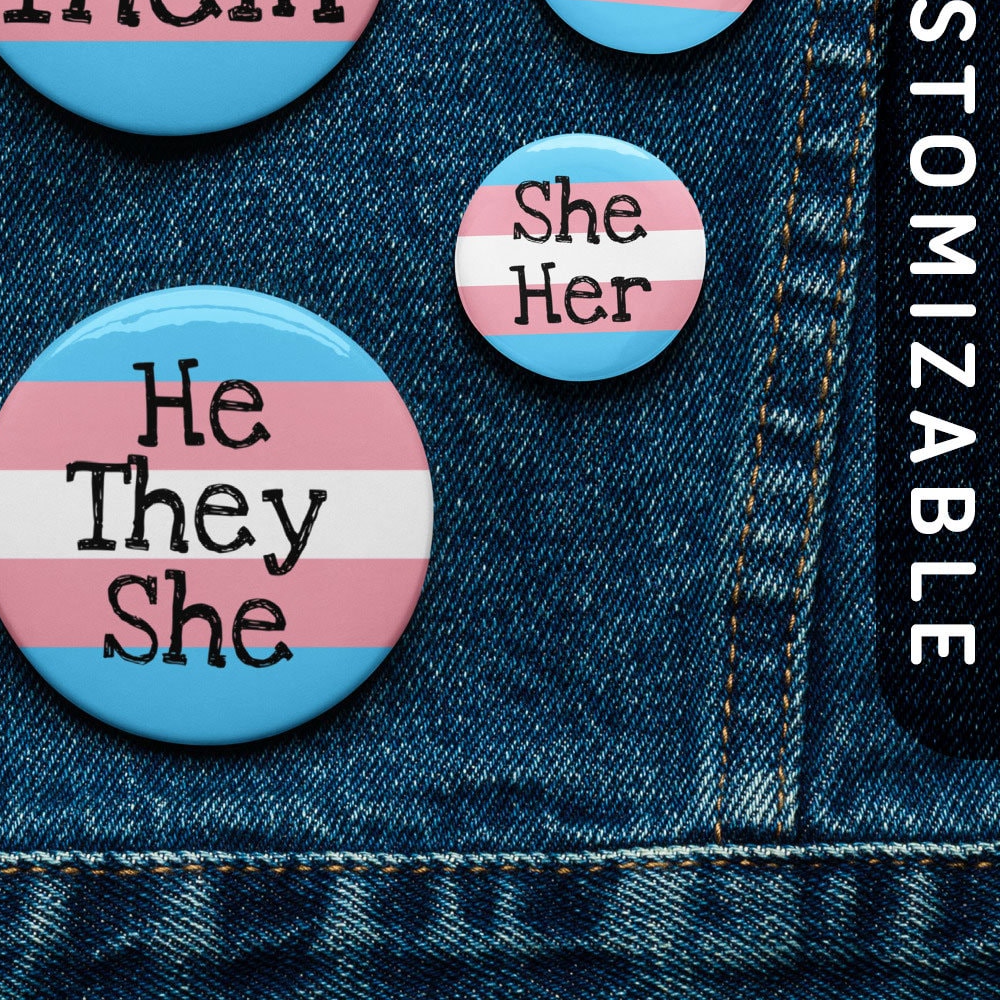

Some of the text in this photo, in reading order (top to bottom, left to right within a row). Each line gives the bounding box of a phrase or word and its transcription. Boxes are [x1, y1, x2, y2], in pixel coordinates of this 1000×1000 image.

[513, 175, 648, 245] She
[508, 261, 652, 326] Her
[132, 357, 271, 450] He
[65, 453, 328, 577] They
[102, 568, 294, 669] She
